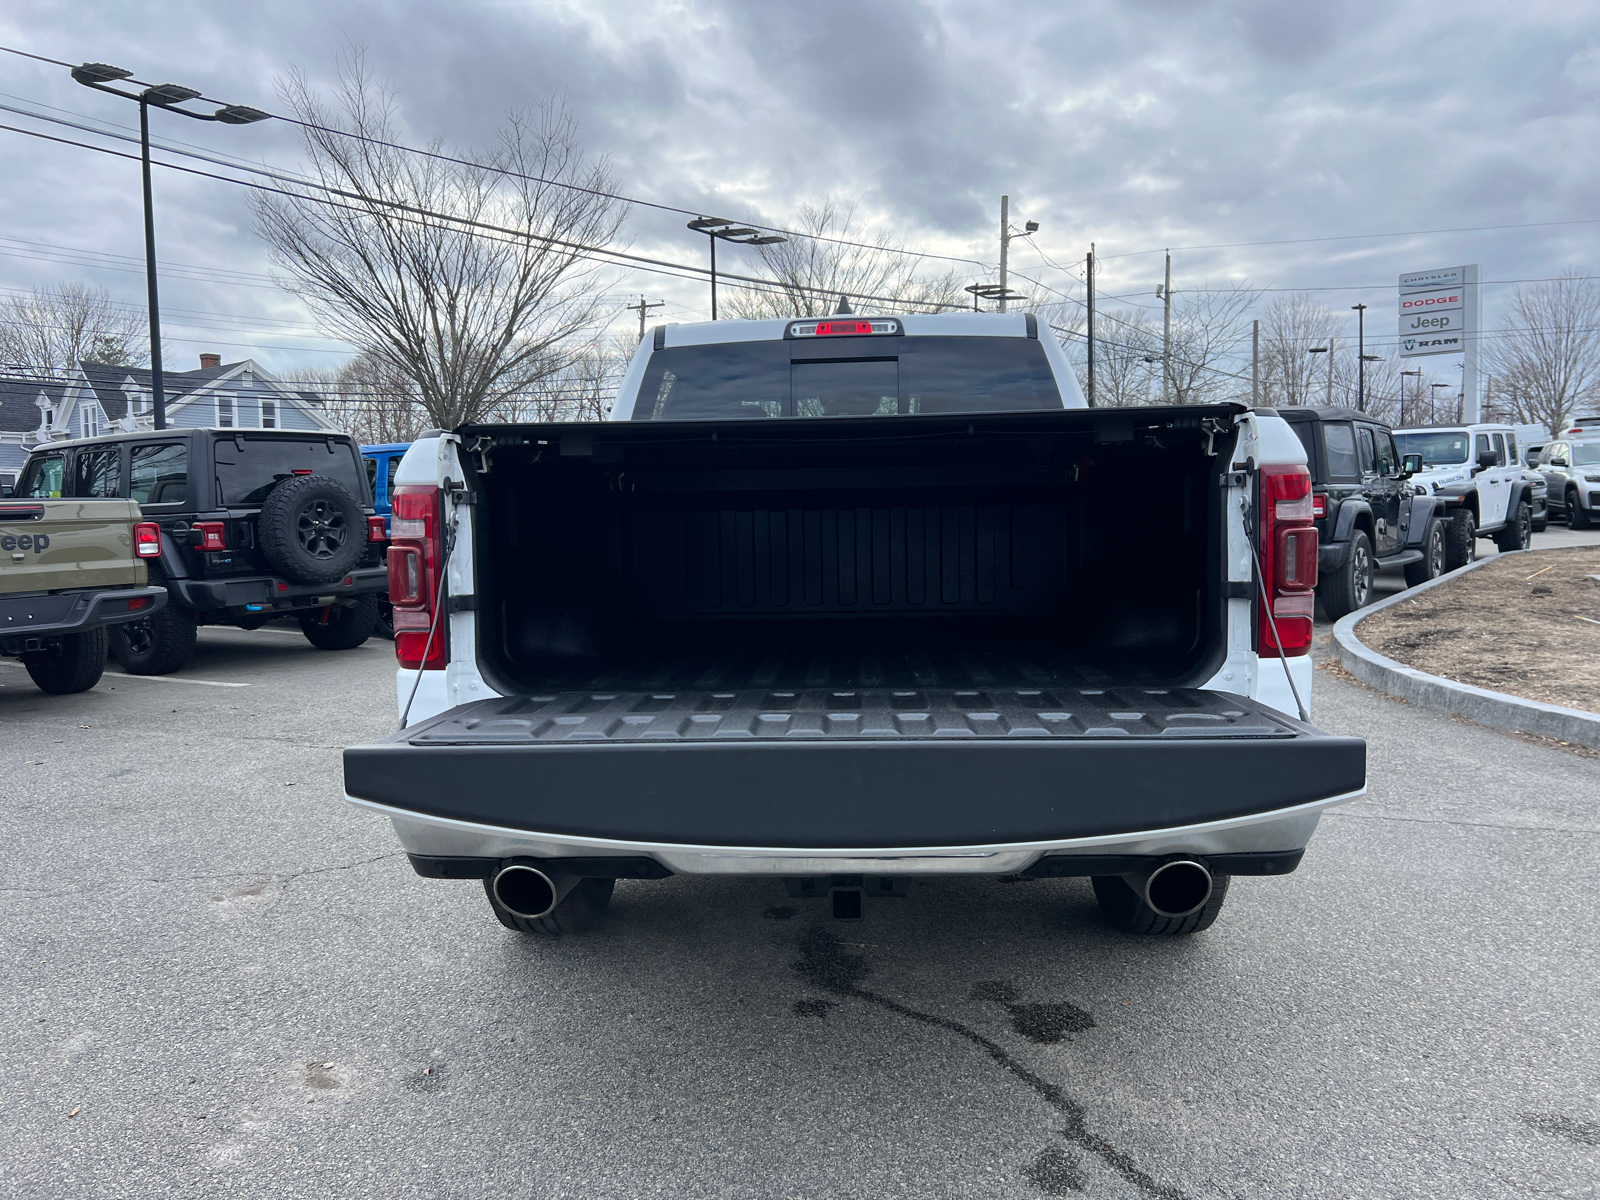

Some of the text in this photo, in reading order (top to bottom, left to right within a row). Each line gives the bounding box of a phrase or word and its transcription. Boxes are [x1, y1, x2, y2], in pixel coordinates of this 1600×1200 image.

[1404, 273, 1457, 283] CHRYSLER
[1403, 296, 1458, 308] DODGE
[1411, 316, 1450, 329] Jeep
[1419, 338, 1458, 347] RAM
[1438, 475, 1465, 485] RUBICON
